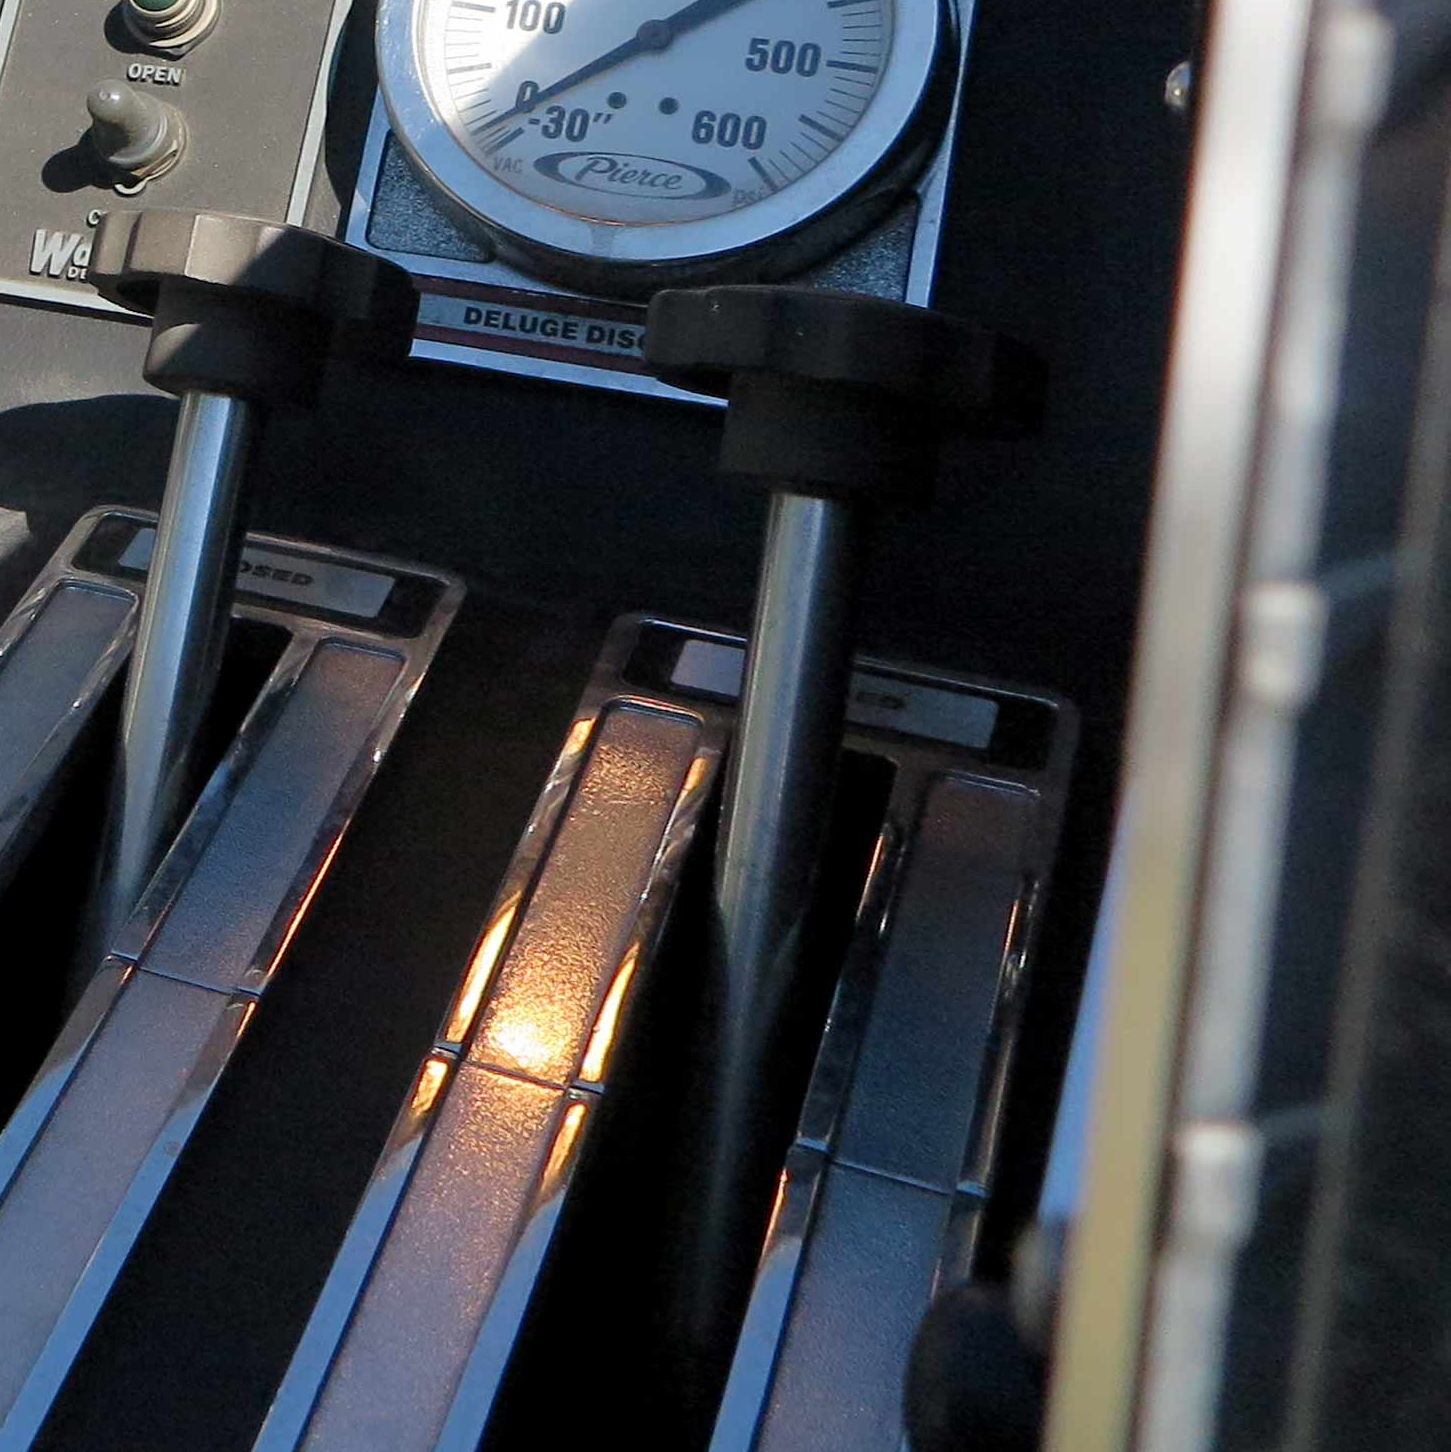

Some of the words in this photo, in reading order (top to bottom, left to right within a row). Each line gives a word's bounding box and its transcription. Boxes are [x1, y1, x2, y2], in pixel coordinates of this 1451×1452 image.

[126, 63, 182, 86] OPEN
[744, 37, 822, 78] 500
[515, 80, 540, 114] 0
[691, 109, 768, 151] 600
[492, 158, 524, 174] VAC
[574, 156, 684, 192] Pierce
[463, 306, 578, 341] DELUGE
